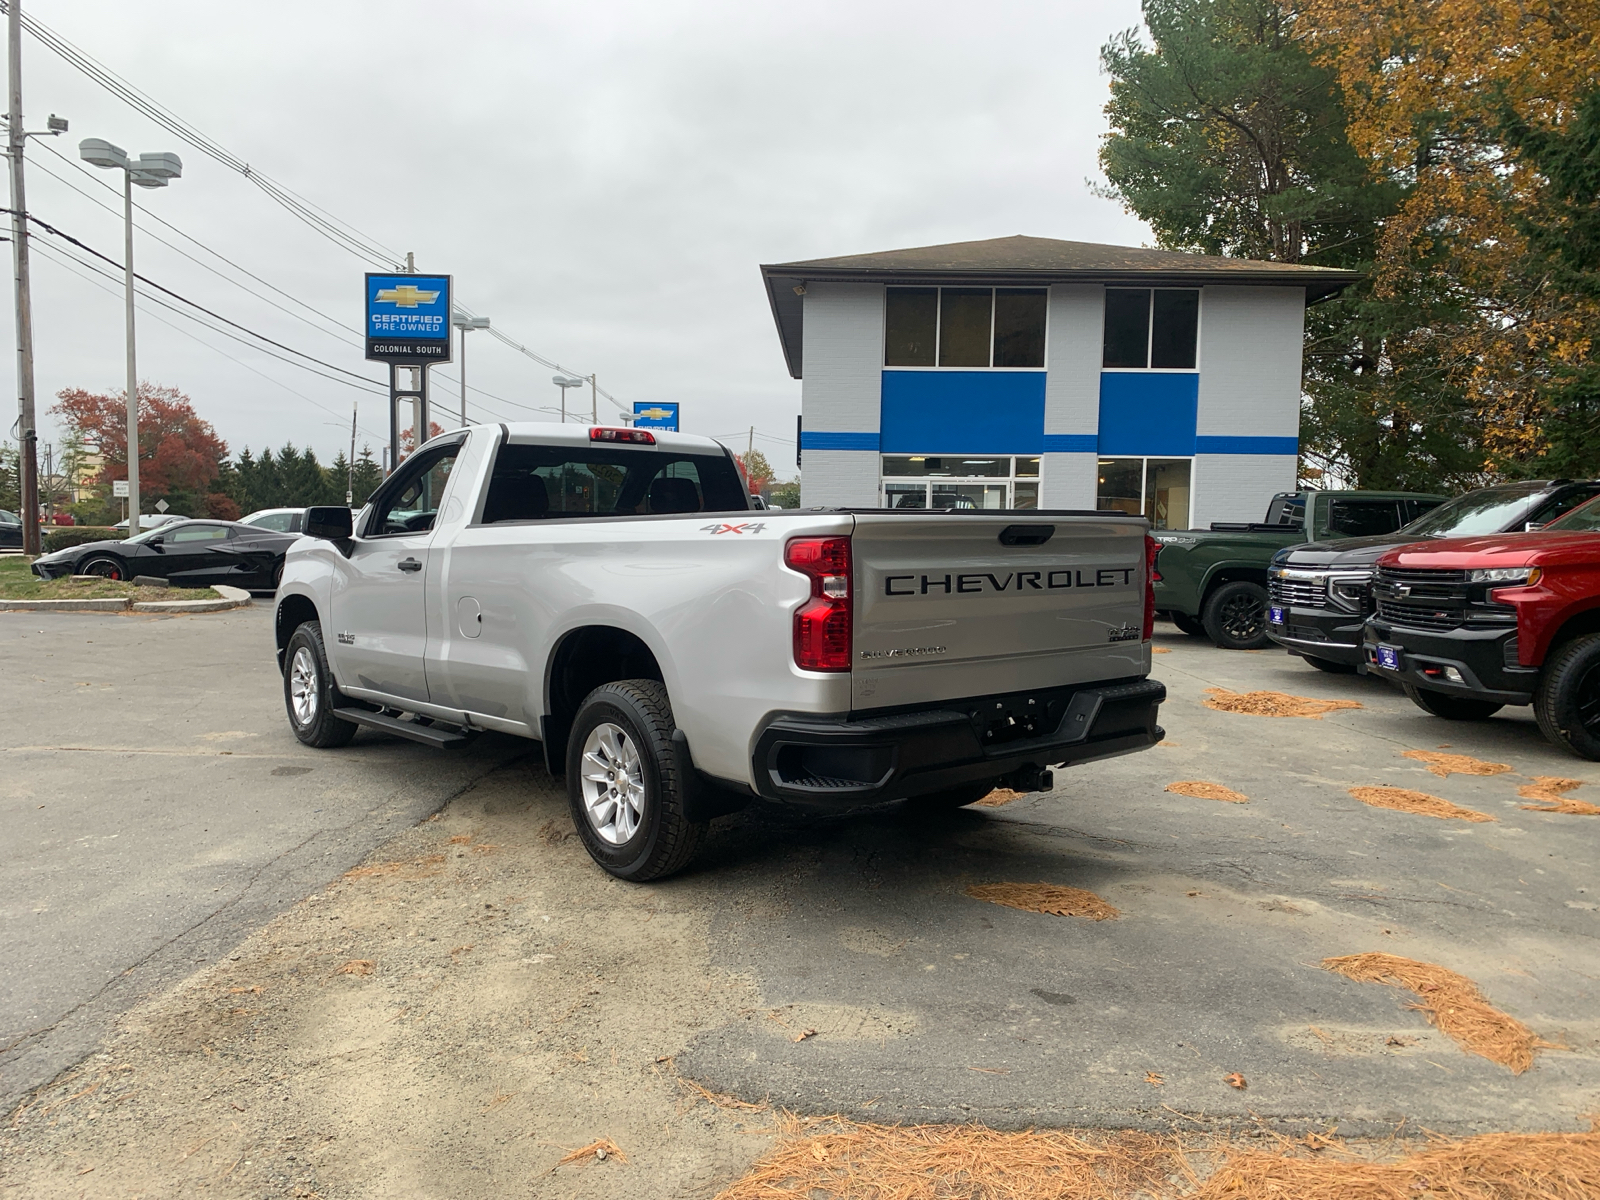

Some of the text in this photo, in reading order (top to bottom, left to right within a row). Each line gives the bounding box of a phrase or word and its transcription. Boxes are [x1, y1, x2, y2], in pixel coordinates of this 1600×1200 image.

[371, 314, 443, 324] CERTIFIED
[375, 323, 440, 332] PRE-OWNED
[374, 345, 441, 354] COLONIAL SOUTH
[885, 568, 1136, 596] CHEVROLET
[860, 646, 947, 660] SILVERADO
